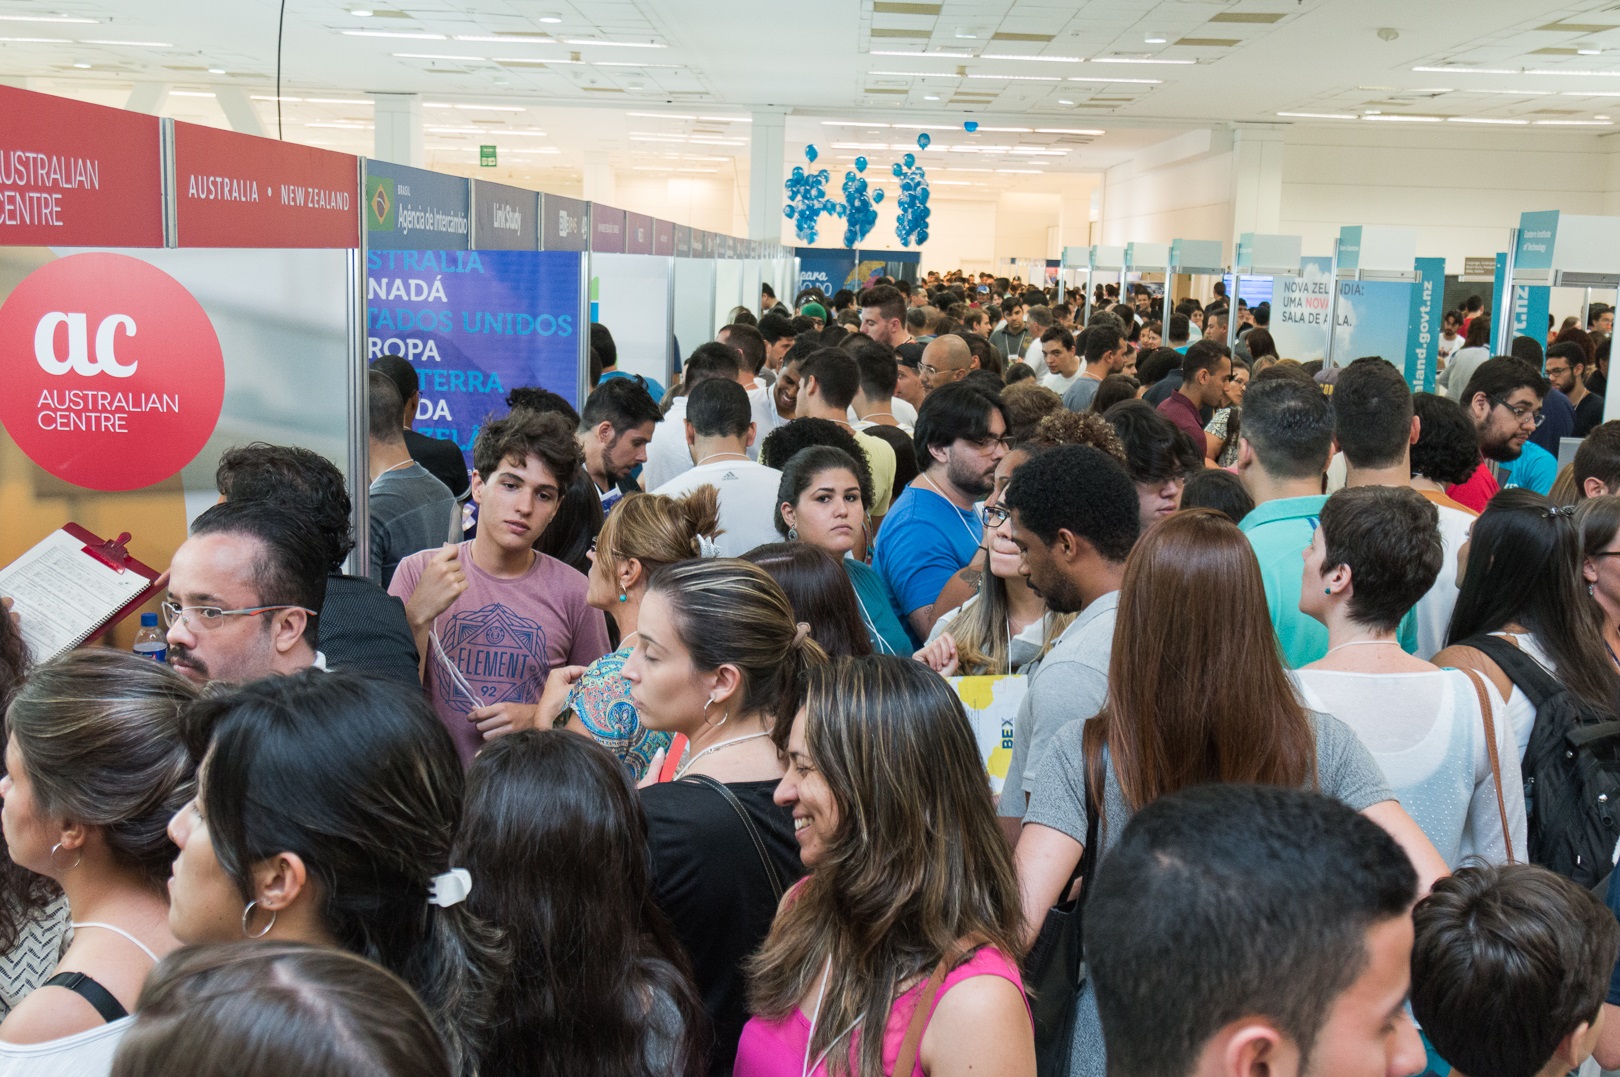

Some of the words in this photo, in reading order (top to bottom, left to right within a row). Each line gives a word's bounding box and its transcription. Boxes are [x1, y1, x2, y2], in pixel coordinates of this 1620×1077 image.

[0, 150, 98, 190] USTRALIAN
[188, 174, 259, 203] AUSTRALIA
[281, 184, 305, 207] NEW
[307, 187, 350, 211] ZEALAND
[397, 184, 411, 197] BRASIL
[397, 203, 425, 235] Agência
[425, 209, 433, 230] de
[433, 208, 468, 235] Intercâmbio
[493, 202, 506, 229] Link
[505, 204, 521, 237] Study
[1284, 281, 1309, 294] NOVA
[1311, 282, 1364, 297] ZELNDIA:
[1283, 296, 1303, 308] UMA
[462, 311, 573, 338] UNIDOS
[1282, 311, 1306, 324] SALA
[1308, 313, 1321, 325] DE
[1323, 313, 1352, 327] ALA.
[34, 311, 138, 378] ac
[368, 337, 441, 361] ROPA
[37, 389, 179, 413] AUSTRALIAN
[415, 398, 453, 421] DA
[38, 410, 129, 433] CENTRE
[458, 648, 530, 680] ELEMENT
[481, 685, 497, 697] 92
[1001, 717, 1014, 749] BEX
